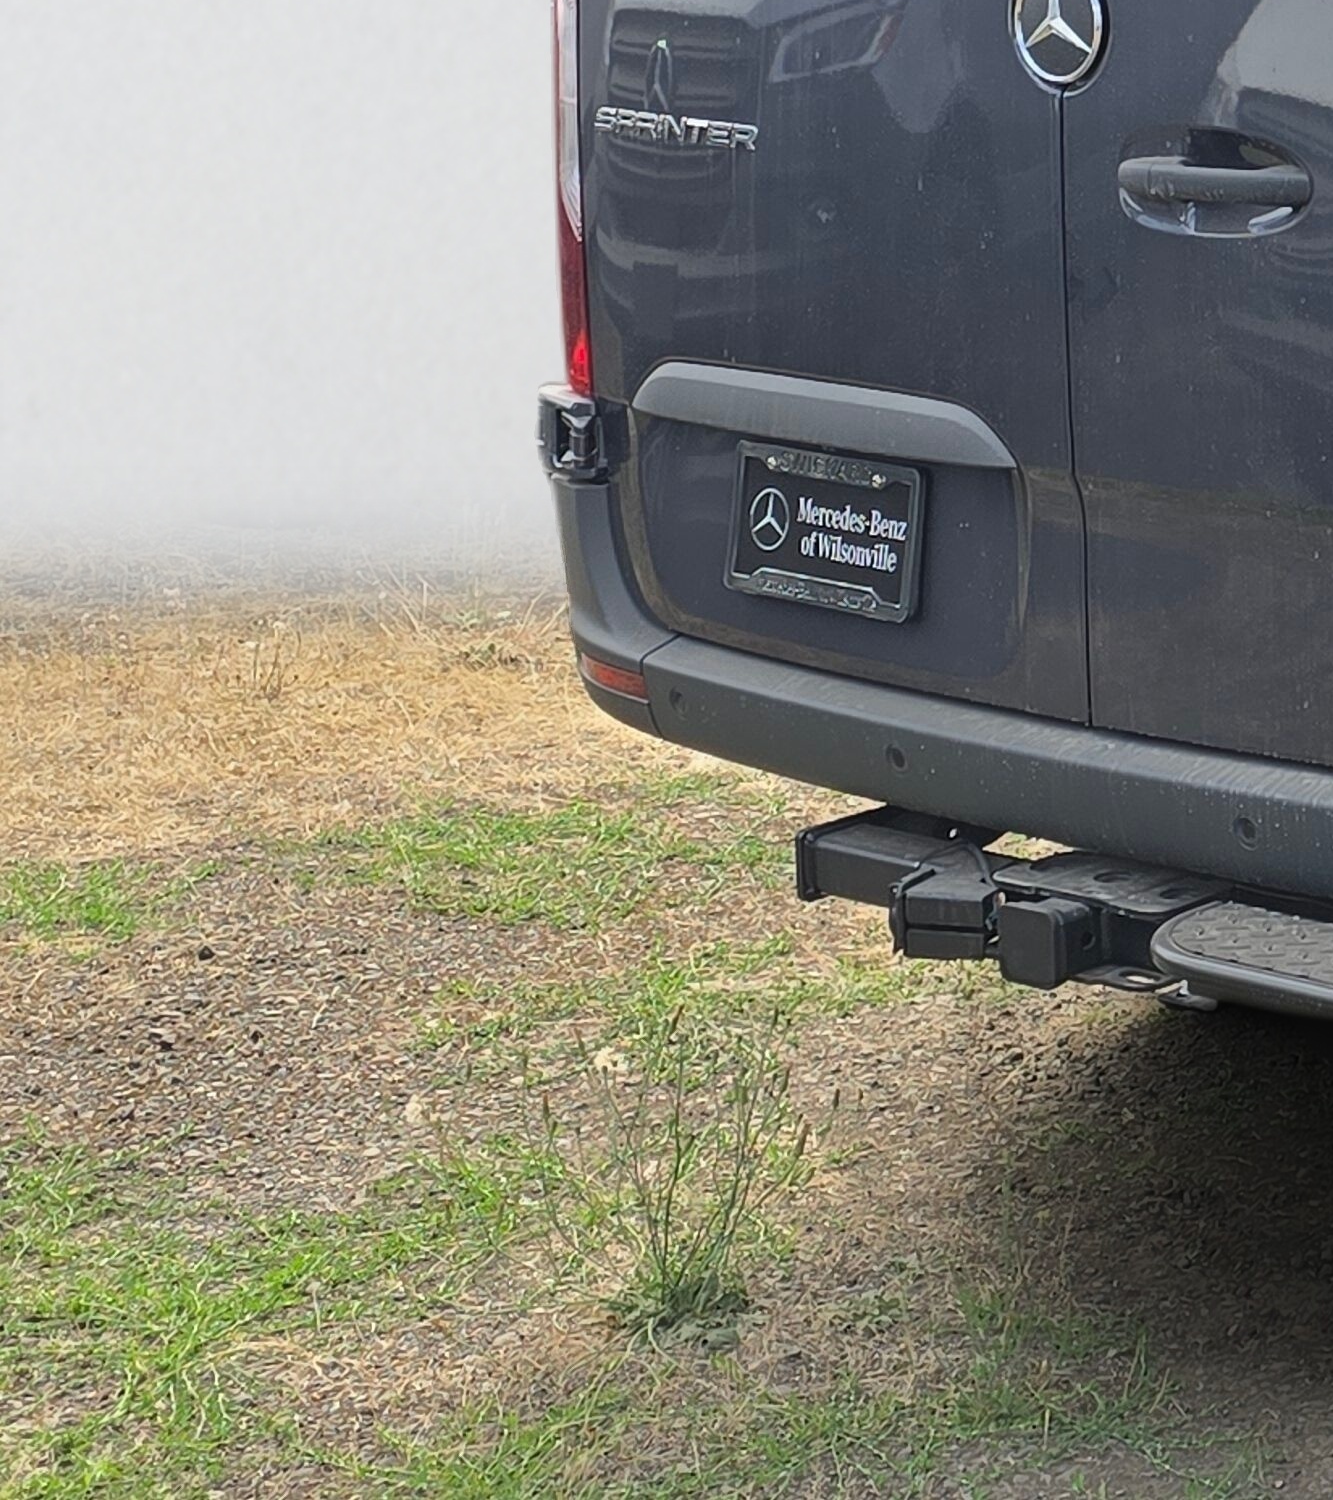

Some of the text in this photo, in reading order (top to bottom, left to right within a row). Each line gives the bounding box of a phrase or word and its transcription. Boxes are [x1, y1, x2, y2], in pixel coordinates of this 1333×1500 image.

[594, 106, 758, 150] SPRINTER
[797, 497, 907, 541] Mercedes-Benz
[801, 532, 897, 573] of Wilsonville
